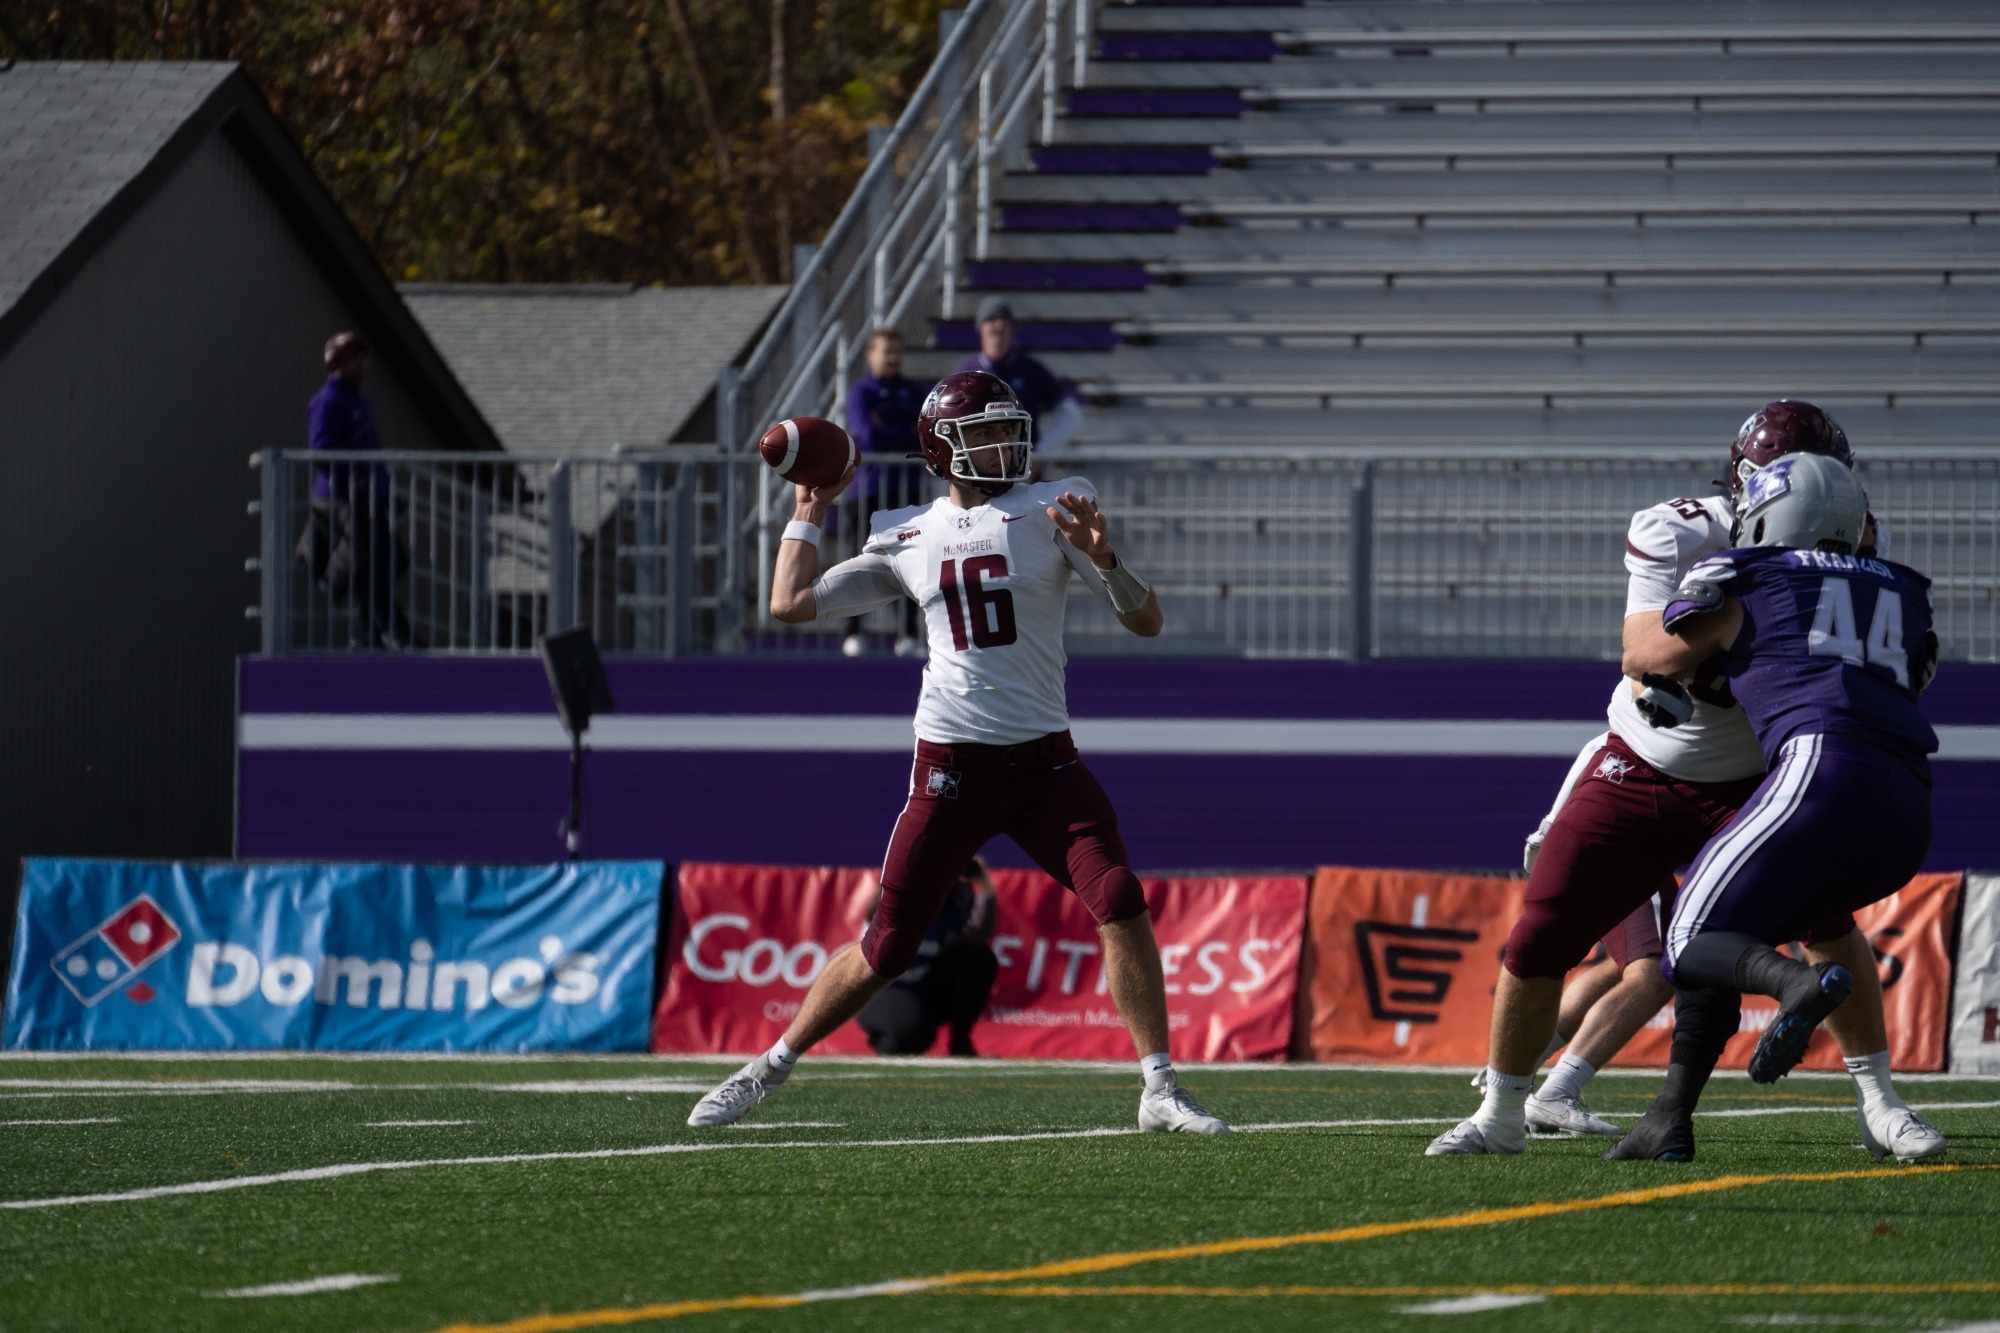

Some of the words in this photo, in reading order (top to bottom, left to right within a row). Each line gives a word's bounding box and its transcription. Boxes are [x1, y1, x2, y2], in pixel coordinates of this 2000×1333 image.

[939, 554, 1018, 652] 16
[1808, 577, 1910, 689] 44
[186, 935, 600, 1011] Domino's
[991, 935, 1274, 996] FITESS
